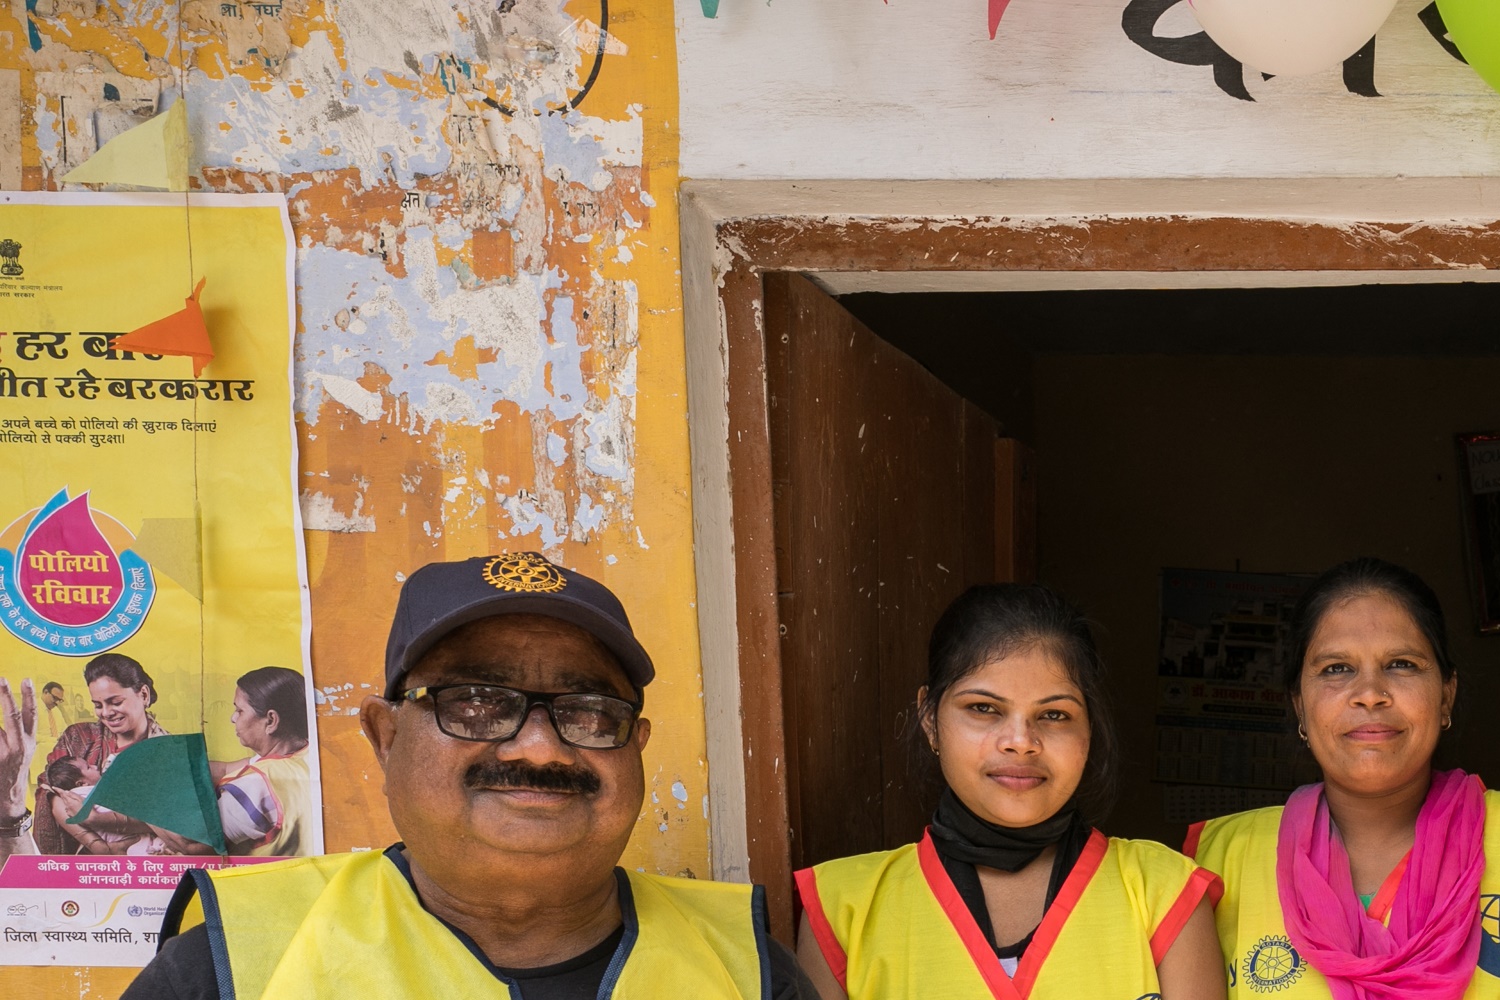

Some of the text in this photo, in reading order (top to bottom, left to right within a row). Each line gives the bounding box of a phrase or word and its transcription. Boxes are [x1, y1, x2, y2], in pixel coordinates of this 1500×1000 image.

[13, 331, 71, 361] हर
[0, 366, 255, 402] ीत रहे बरकरार
[2, 416, 31, 430] अपने
[34, 416, 57, 430] बच्चे
[61, 416, 77, 430] को
[80, 416, 119, 431] पोलियो
[123, 417, 139, 431] की
[41, 431, 52, 444] से
[55, 431, 86, 444] पक्की
[28, 549, 110, 573] पोलियो
[31, 579, 112, 605] रविवार
[37, 859, 70, 872] अधिक
[75, 860, 121, 873] जानकारी
[126, 859, 138, 872] के
[143, 860, 164, 873] लिए
[78, 873, 132, 887] आंगनवाड़ी
[4, 926, 37, 943] जिला
[42, 929, 87, 943] स्वास्थ्य
